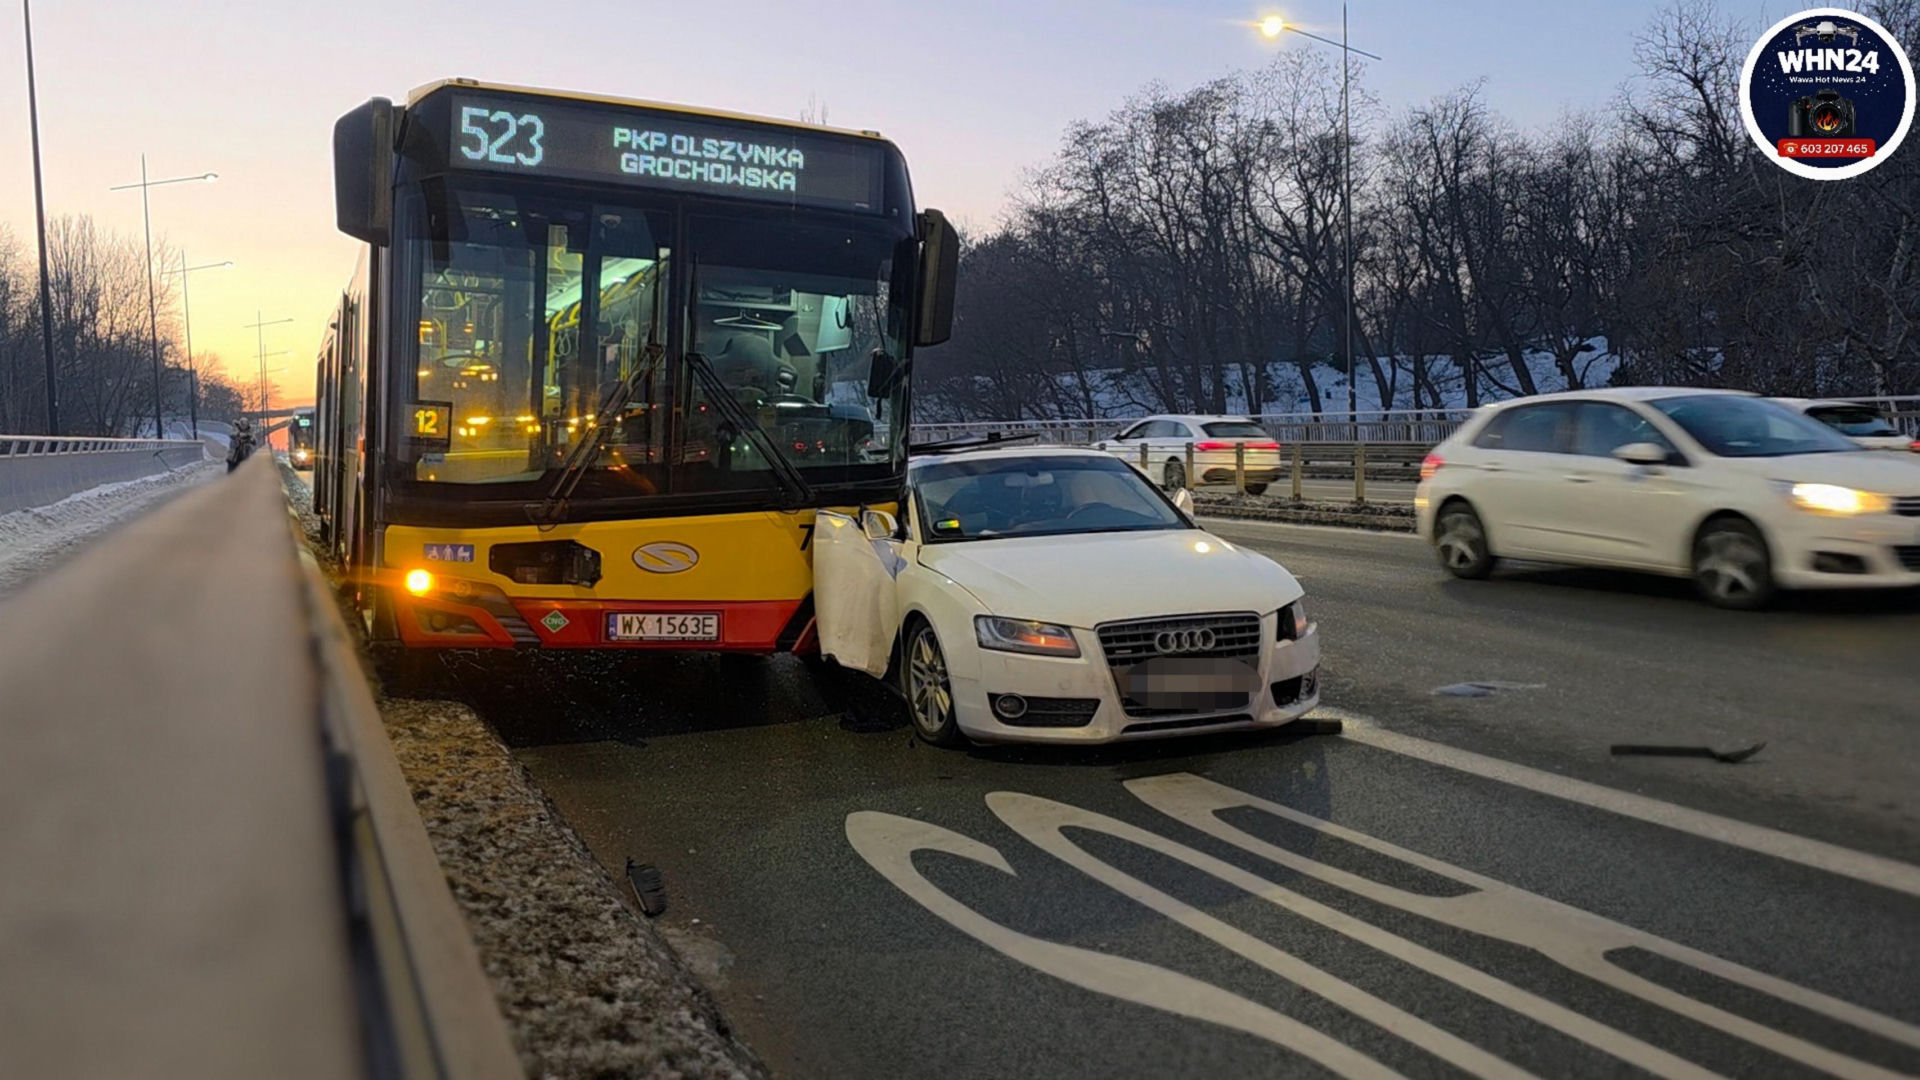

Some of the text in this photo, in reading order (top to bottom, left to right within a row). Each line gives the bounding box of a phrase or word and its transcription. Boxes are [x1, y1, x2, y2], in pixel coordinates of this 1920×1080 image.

[461, 106, 544, 167] 523
[613, 126, 804, 169] PKP OLSZYNKA
[620, 152, 797, 191] GROCHOWSKA
[414, 409, 438, 434] 12
[621, 616, 647, 635] WX
[655, 616, 713, 636] 1563E
